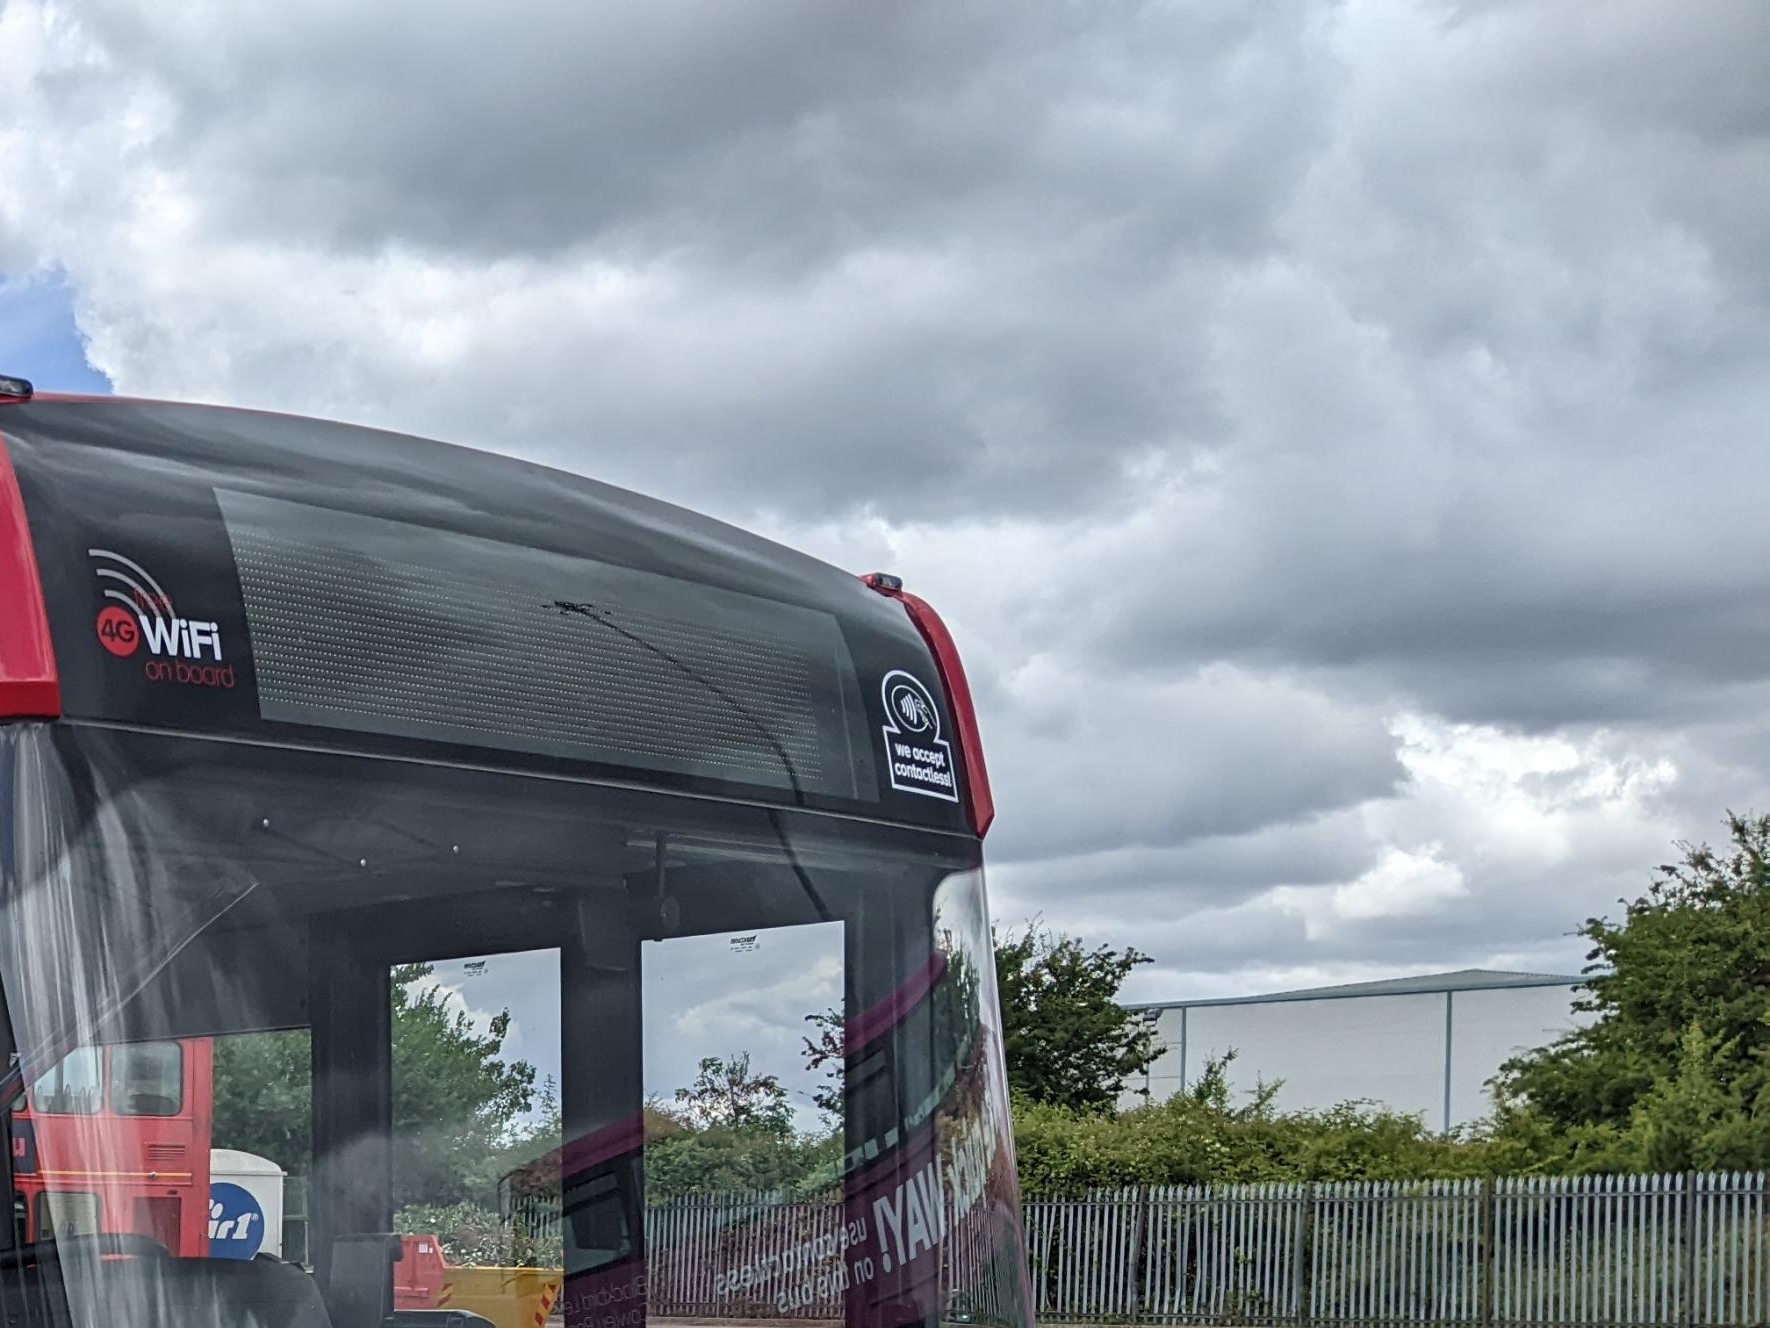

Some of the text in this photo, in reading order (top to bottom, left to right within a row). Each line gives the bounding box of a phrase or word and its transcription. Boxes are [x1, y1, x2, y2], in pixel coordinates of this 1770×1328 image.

[100, 615, 222, 661] 4G WiFi
[145, 660, 234, 688] on board
[894, 743, 946, 768] we accept
[894, 762, 952, 787] contactless!
[209, 1202, 251, 1240] ir1
